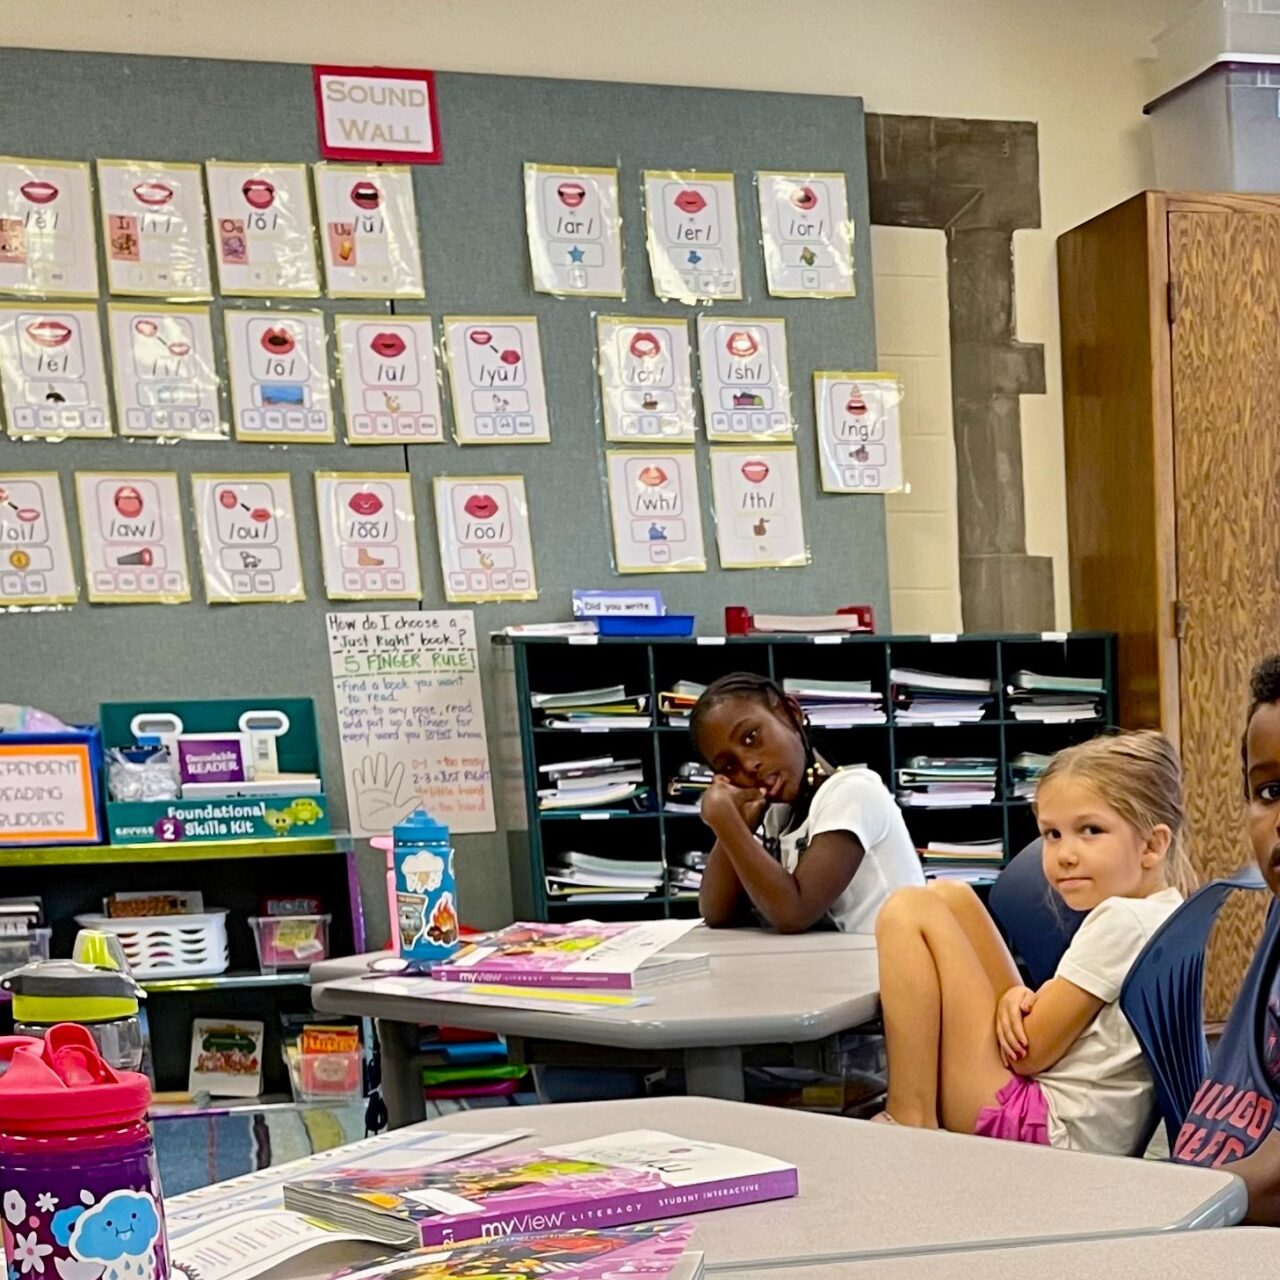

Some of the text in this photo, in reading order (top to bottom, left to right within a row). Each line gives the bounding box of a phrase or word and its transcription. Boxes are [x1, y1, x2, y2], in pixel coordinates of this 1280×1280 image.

[325, 80, 427, 109] SOUND
[338, 117, 421, 146] WALL
[556, 218, 592, 235] /ar/
[676, 223, 712, 241] /er/
[727, 363, 762, 380] /sh/
[841, 420, 876, 442] /ng/
[636, 494, 678, 511] /wh/
[742, 492, 774, 508] /th/
[109, 520, 155, 538] /aw/
[229, 522, 268, 540] /ou/
[584, 602, 649, 612] Did you write
[329, 614, 457, 632] How do I choose a
[344, 655, 361, 673] 5
[367, 653, 422, 671] FINGER
[383, 677, 409, 691] book
[415, 680, 432, 692] you
[437, 675, 464, 687] want
[348, 692, 397, 703] to read
[372, 705, 384, 715] to
[187, 761, 240, 774] READER
[167, 802, 266, 820] Foundational
[162, 823, 175, 840] 2
[184, 819, 255, 836] Skills Kit
[481, 1211, 566, 1240] myView
[571, 1204, 642, 1222] LITERACY
[658, 1193, 699, 1207] STUDENT
[702, 1184, 760, 1201] INTERACTIVE
